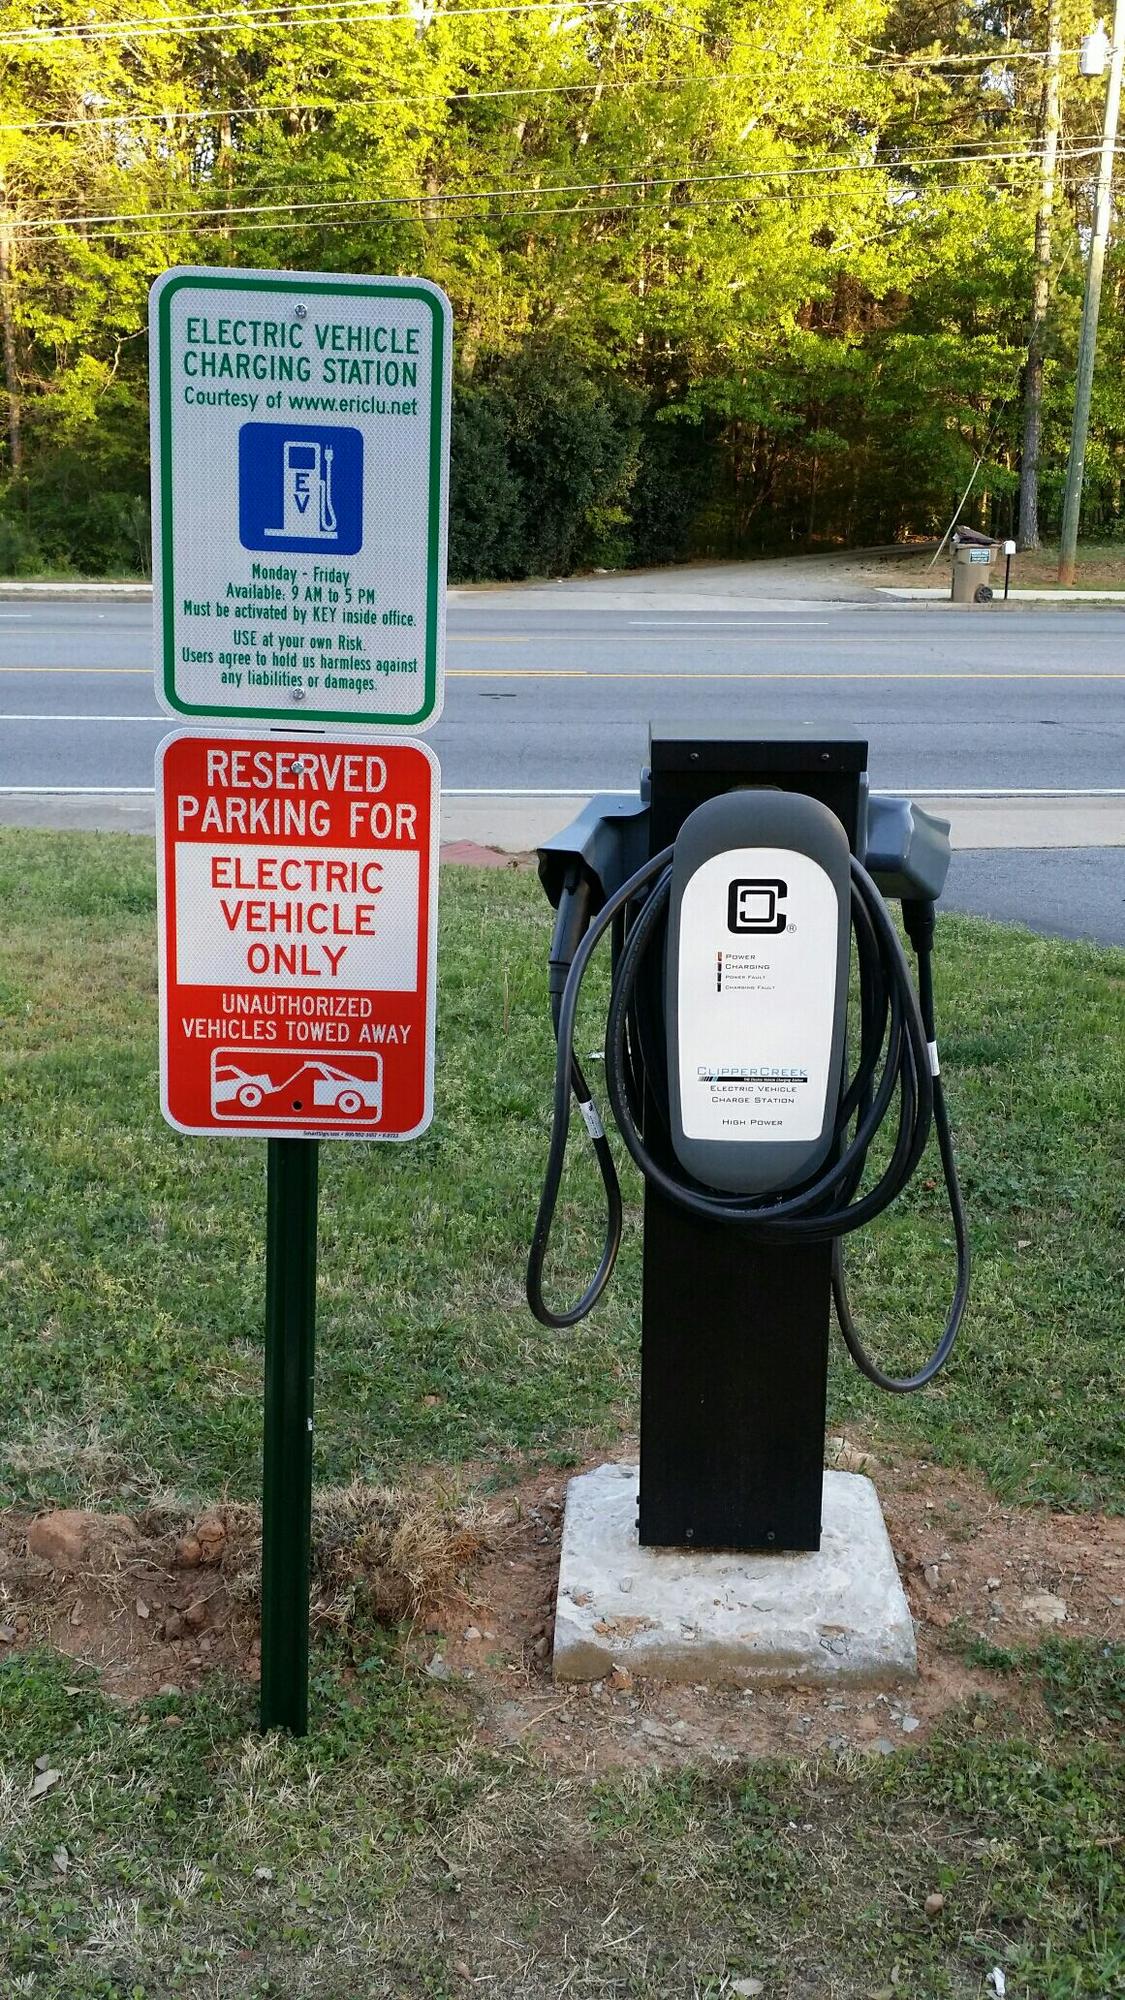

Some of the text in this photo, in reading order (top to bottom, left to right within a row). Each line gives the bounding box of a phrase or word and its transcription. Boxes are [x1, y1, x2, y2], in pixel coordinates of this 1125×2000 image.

[187, 318, 420, 355] ELECTRIC VEHICLE
[184, 351, 418, 387] CHARGING STATION
[184, 386, 418, 416] Courtesy of www.ericlu.net
[252, 563, 298, 583] Monday
[313, 567, 350, 587] Friday
[226, 583, 375, 605] Available: 9 AM to 5 PM
[184, 600, 417, 627] Must be activated by KEY inside office.
[233, 630, 366, 652] USE at your own Risk.
[182, 648, 417, 676] Users agree to hold us harmless against
[221, 670, 377, 694] any liabilities or damages.
[207, 750, 388, 793] RESERVED
[177, 795, 418, 840] PARKING FOR
[211, 856, 384, 894] ELECTRIC
[220, 899, 376, 936] VEHICLE
[246, 943, 348, 977] ONLY
[222, 993, 373, 1018] UNAUTHORIZED
[182, 1018, 411, 1045] VEHICLES TOWED AWAY
